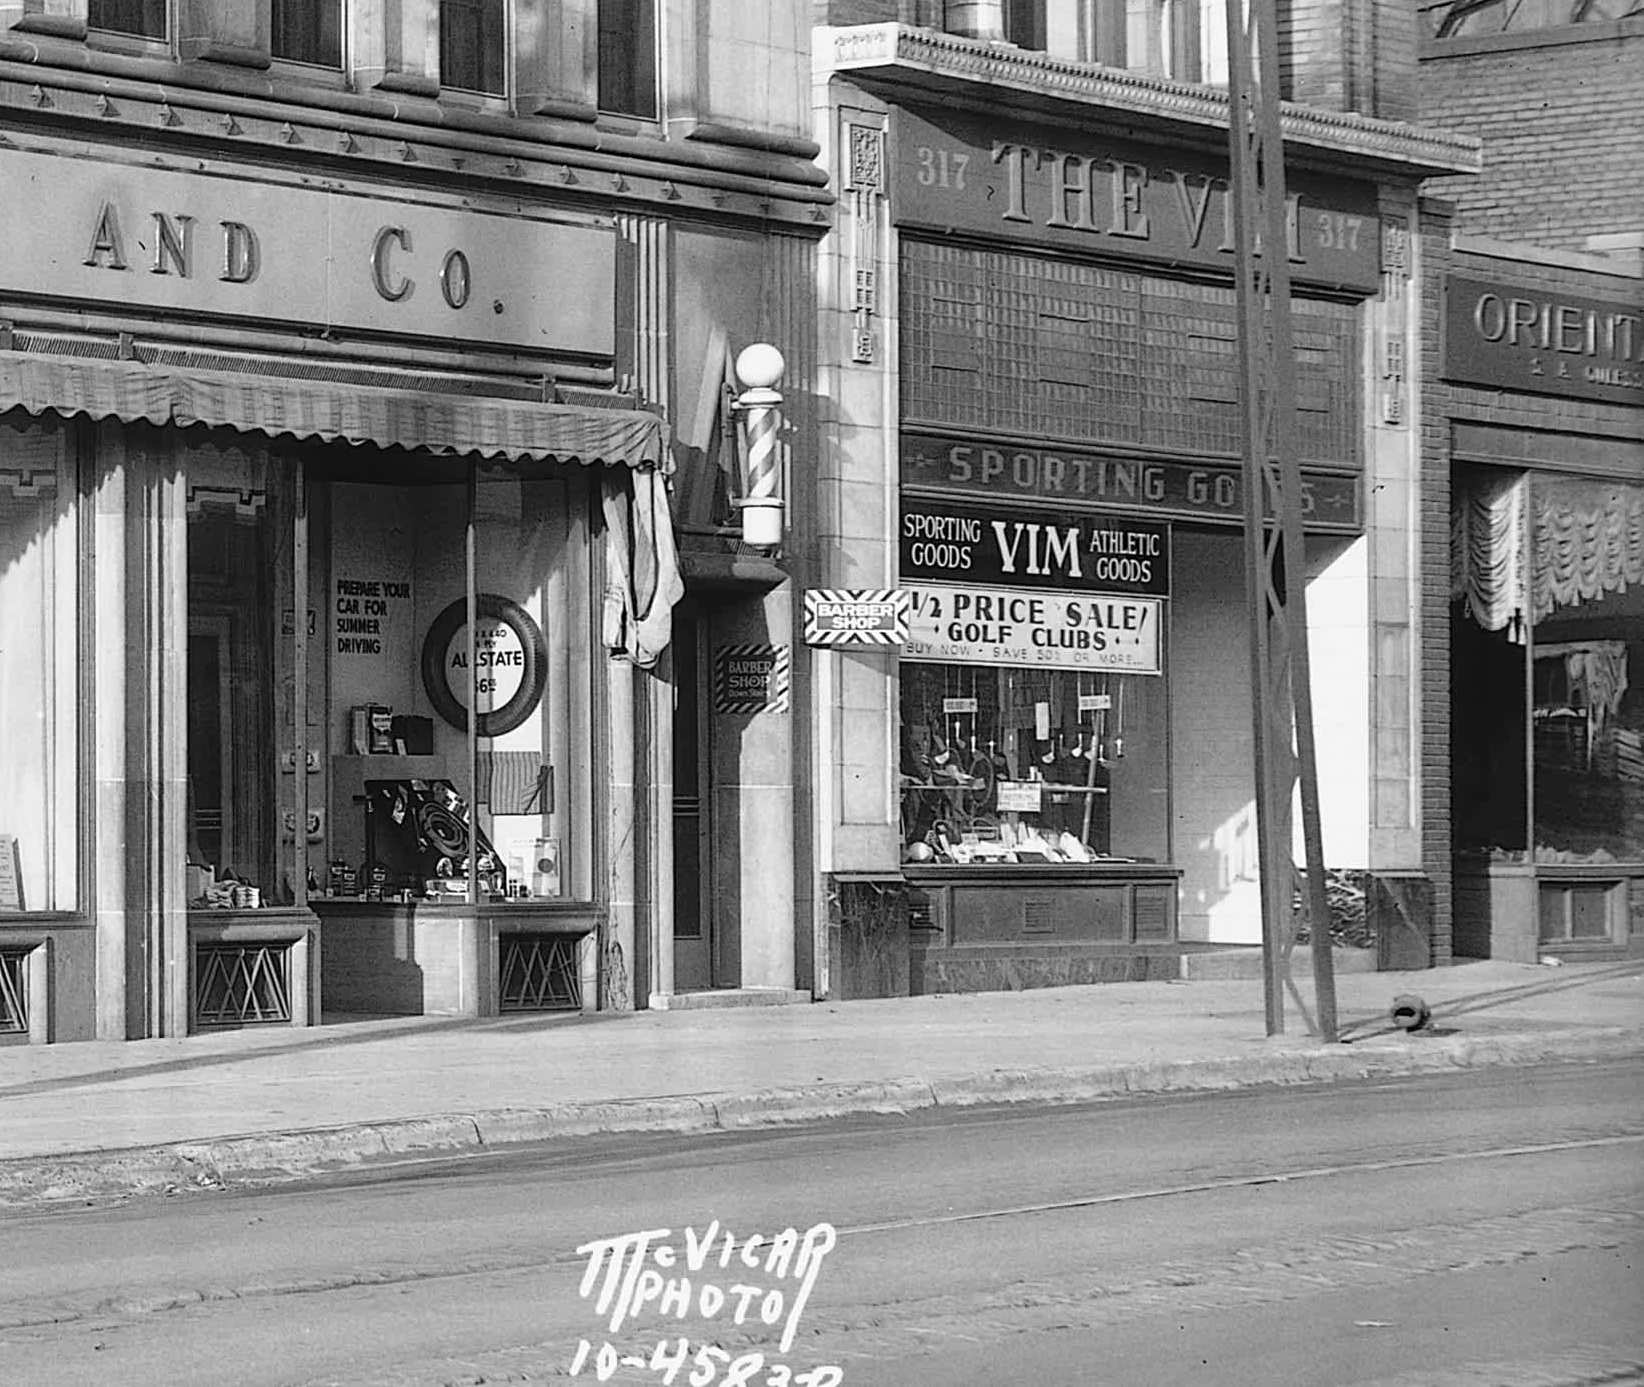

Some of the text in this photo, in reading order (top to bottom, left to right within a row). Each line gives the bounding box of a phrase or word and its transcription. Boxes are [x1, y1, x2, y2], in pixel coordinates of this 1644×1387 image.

[917, 146, 970, 191] 317
[991, 139, 1151, 241] THE
[83, 198, 260, 284] AND
[1317, 213, 1362, 252] 317
[1473, 292, 1644, 362] ORIENT
[947, 445, 1314, 513] SPORTING GOS
[904, 513, 981, 543] SPORTING
[912, 542, 972, 569] GOODS
[991, 520, 1082, 578] VIM
[1089, 529, 1160, 556] ATHLETIC
[1096, 557, 1152, 583] GOODS
[337, 579, 411, 599] PREPARE YOUR
[336, 597, 388, 617] CAR FOR
[818, 603, 894, 618] BARBER
[953, 593, 1045, 625] PRICE
[336, 618, 381, 635] SUMMER
[831, 616, 882, 630] SHOP
[947, 621, 1107, 651] GOLF CLUBS
[337, 637, 382, 655] DRIVING
[907, 642, 932, 655] BUY
[940, 644, 971, 656] NOW
[992, 646, 1028, 660] SAVE
[728, 661, 772, 674] BARBER
[728, 675, 770, 689] SHOP
